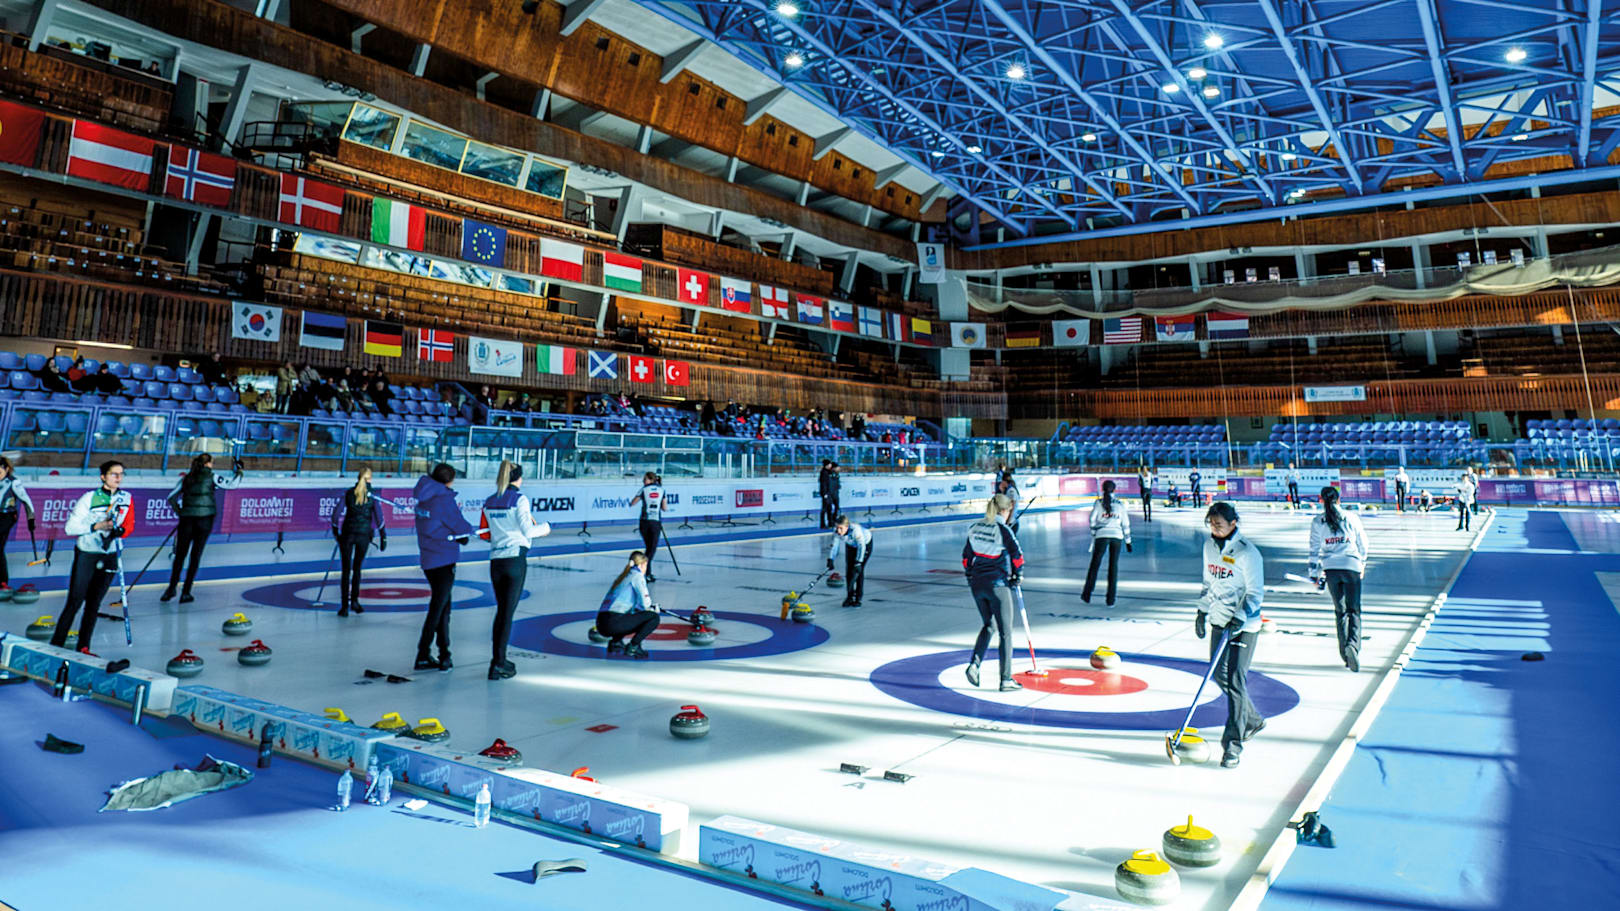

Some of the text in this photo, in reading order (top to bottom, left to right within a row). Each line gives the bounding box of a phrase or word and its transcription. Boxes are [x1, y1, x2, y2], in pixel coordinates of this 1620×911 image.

[240, 507, 293, 517] BELLUNESI
[531, 497, 575, 512] HOWDEN
[1325, 537, 1350, 545] KOREA
[554, 801, 591, 824] Cortina
[606, 814, 645, 838] Cortina
[712, 843, 755, 869] Cortina
[775, 859, 821, 885] Cortina
[842, 875, 892, 903] Cortina
